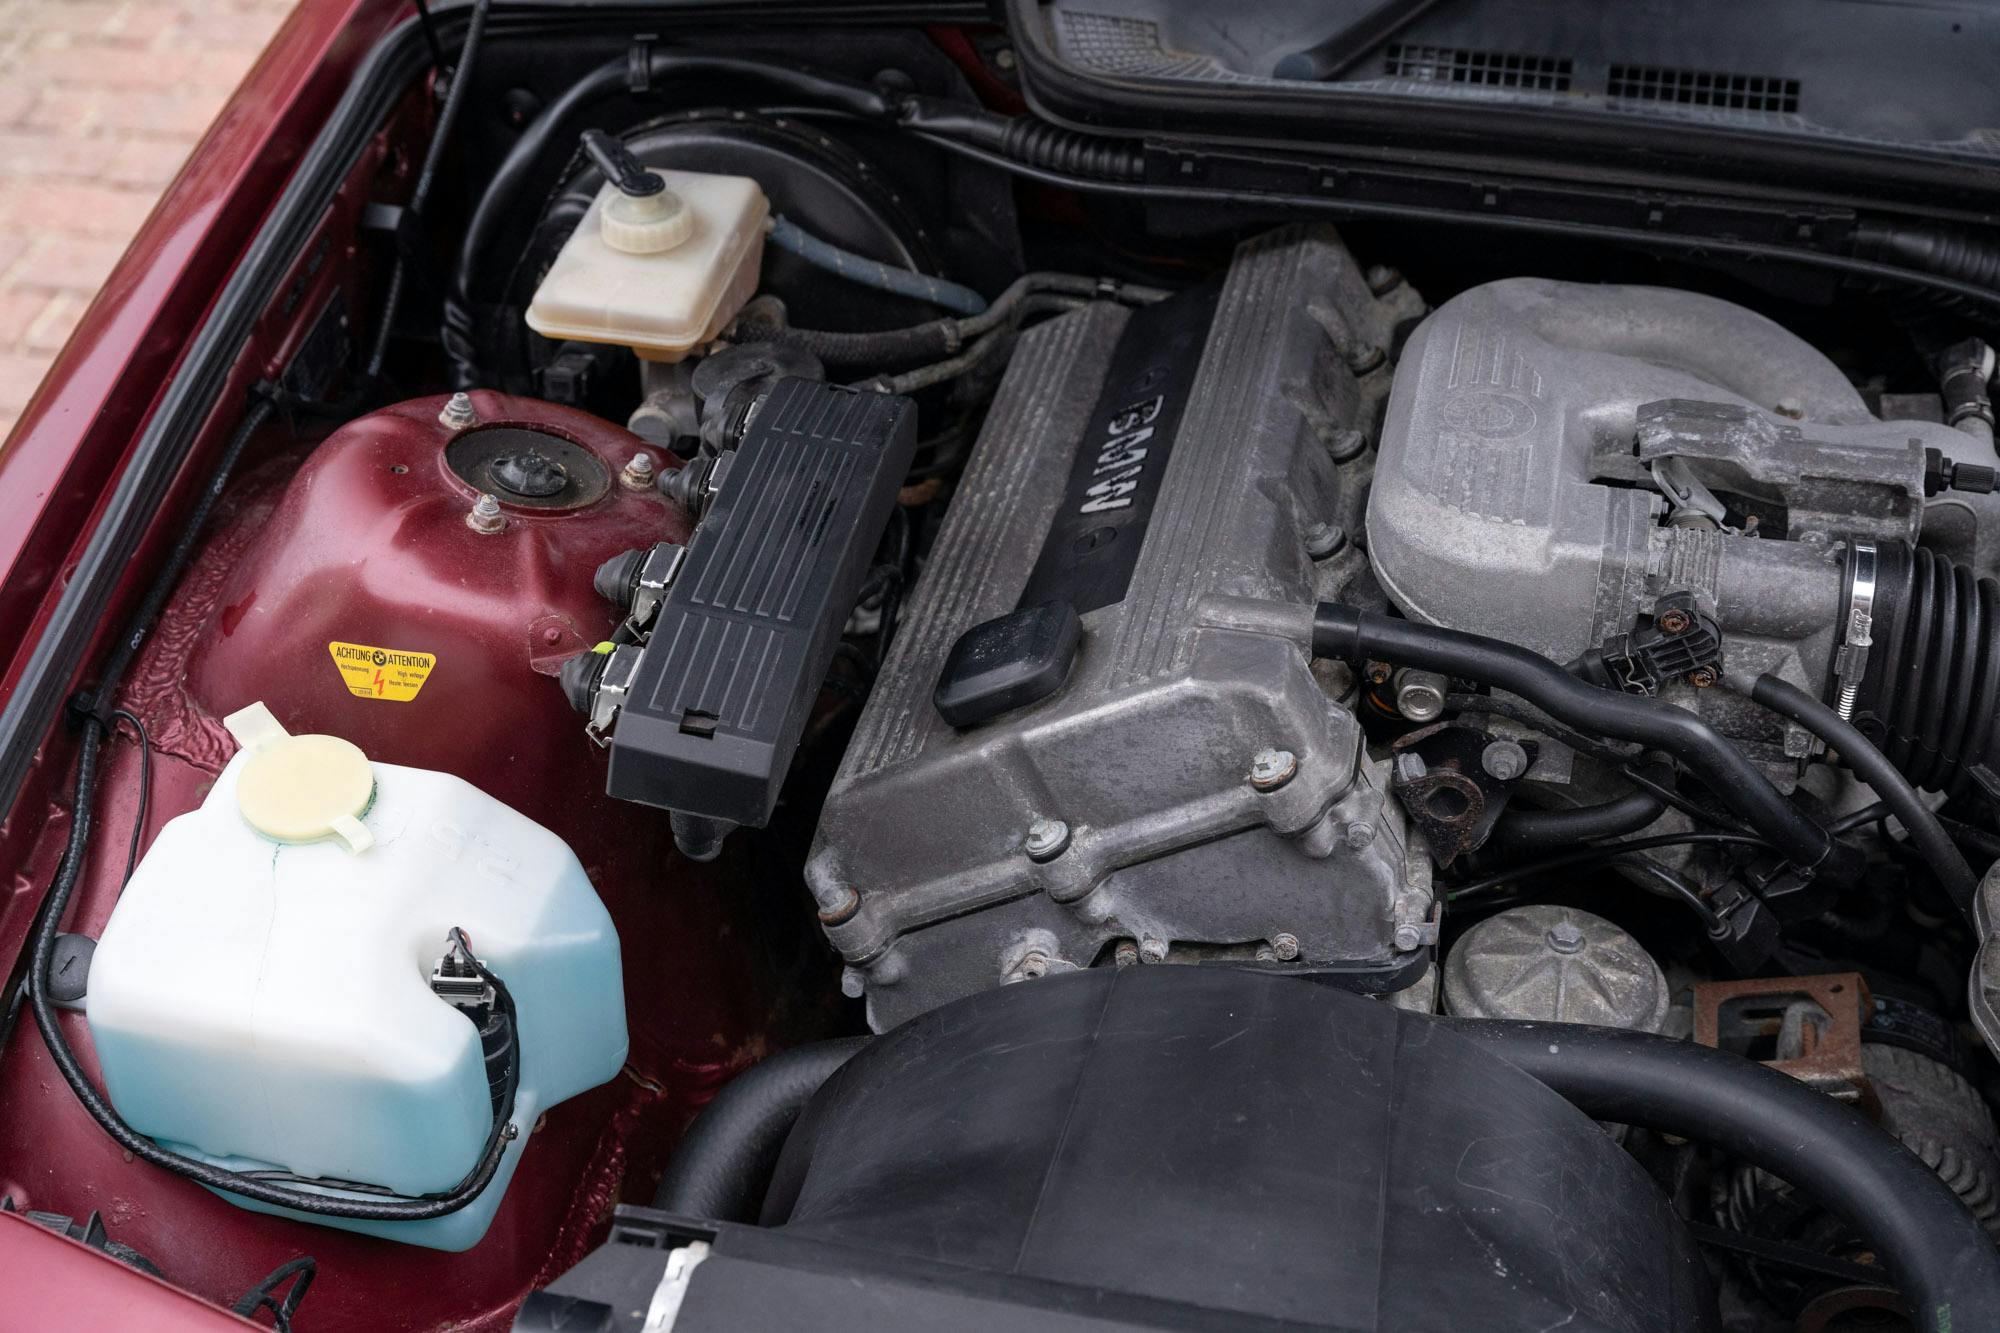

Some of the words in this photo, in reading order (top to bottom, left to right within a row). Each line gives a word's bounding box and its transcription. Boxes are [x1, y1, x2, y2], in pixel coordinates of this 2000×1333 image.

[1080, 394, 1164, 513] BMW
[336, 646, 371, 662] ACHTUNG
[387, 654, 430, 669] ATTENTION
